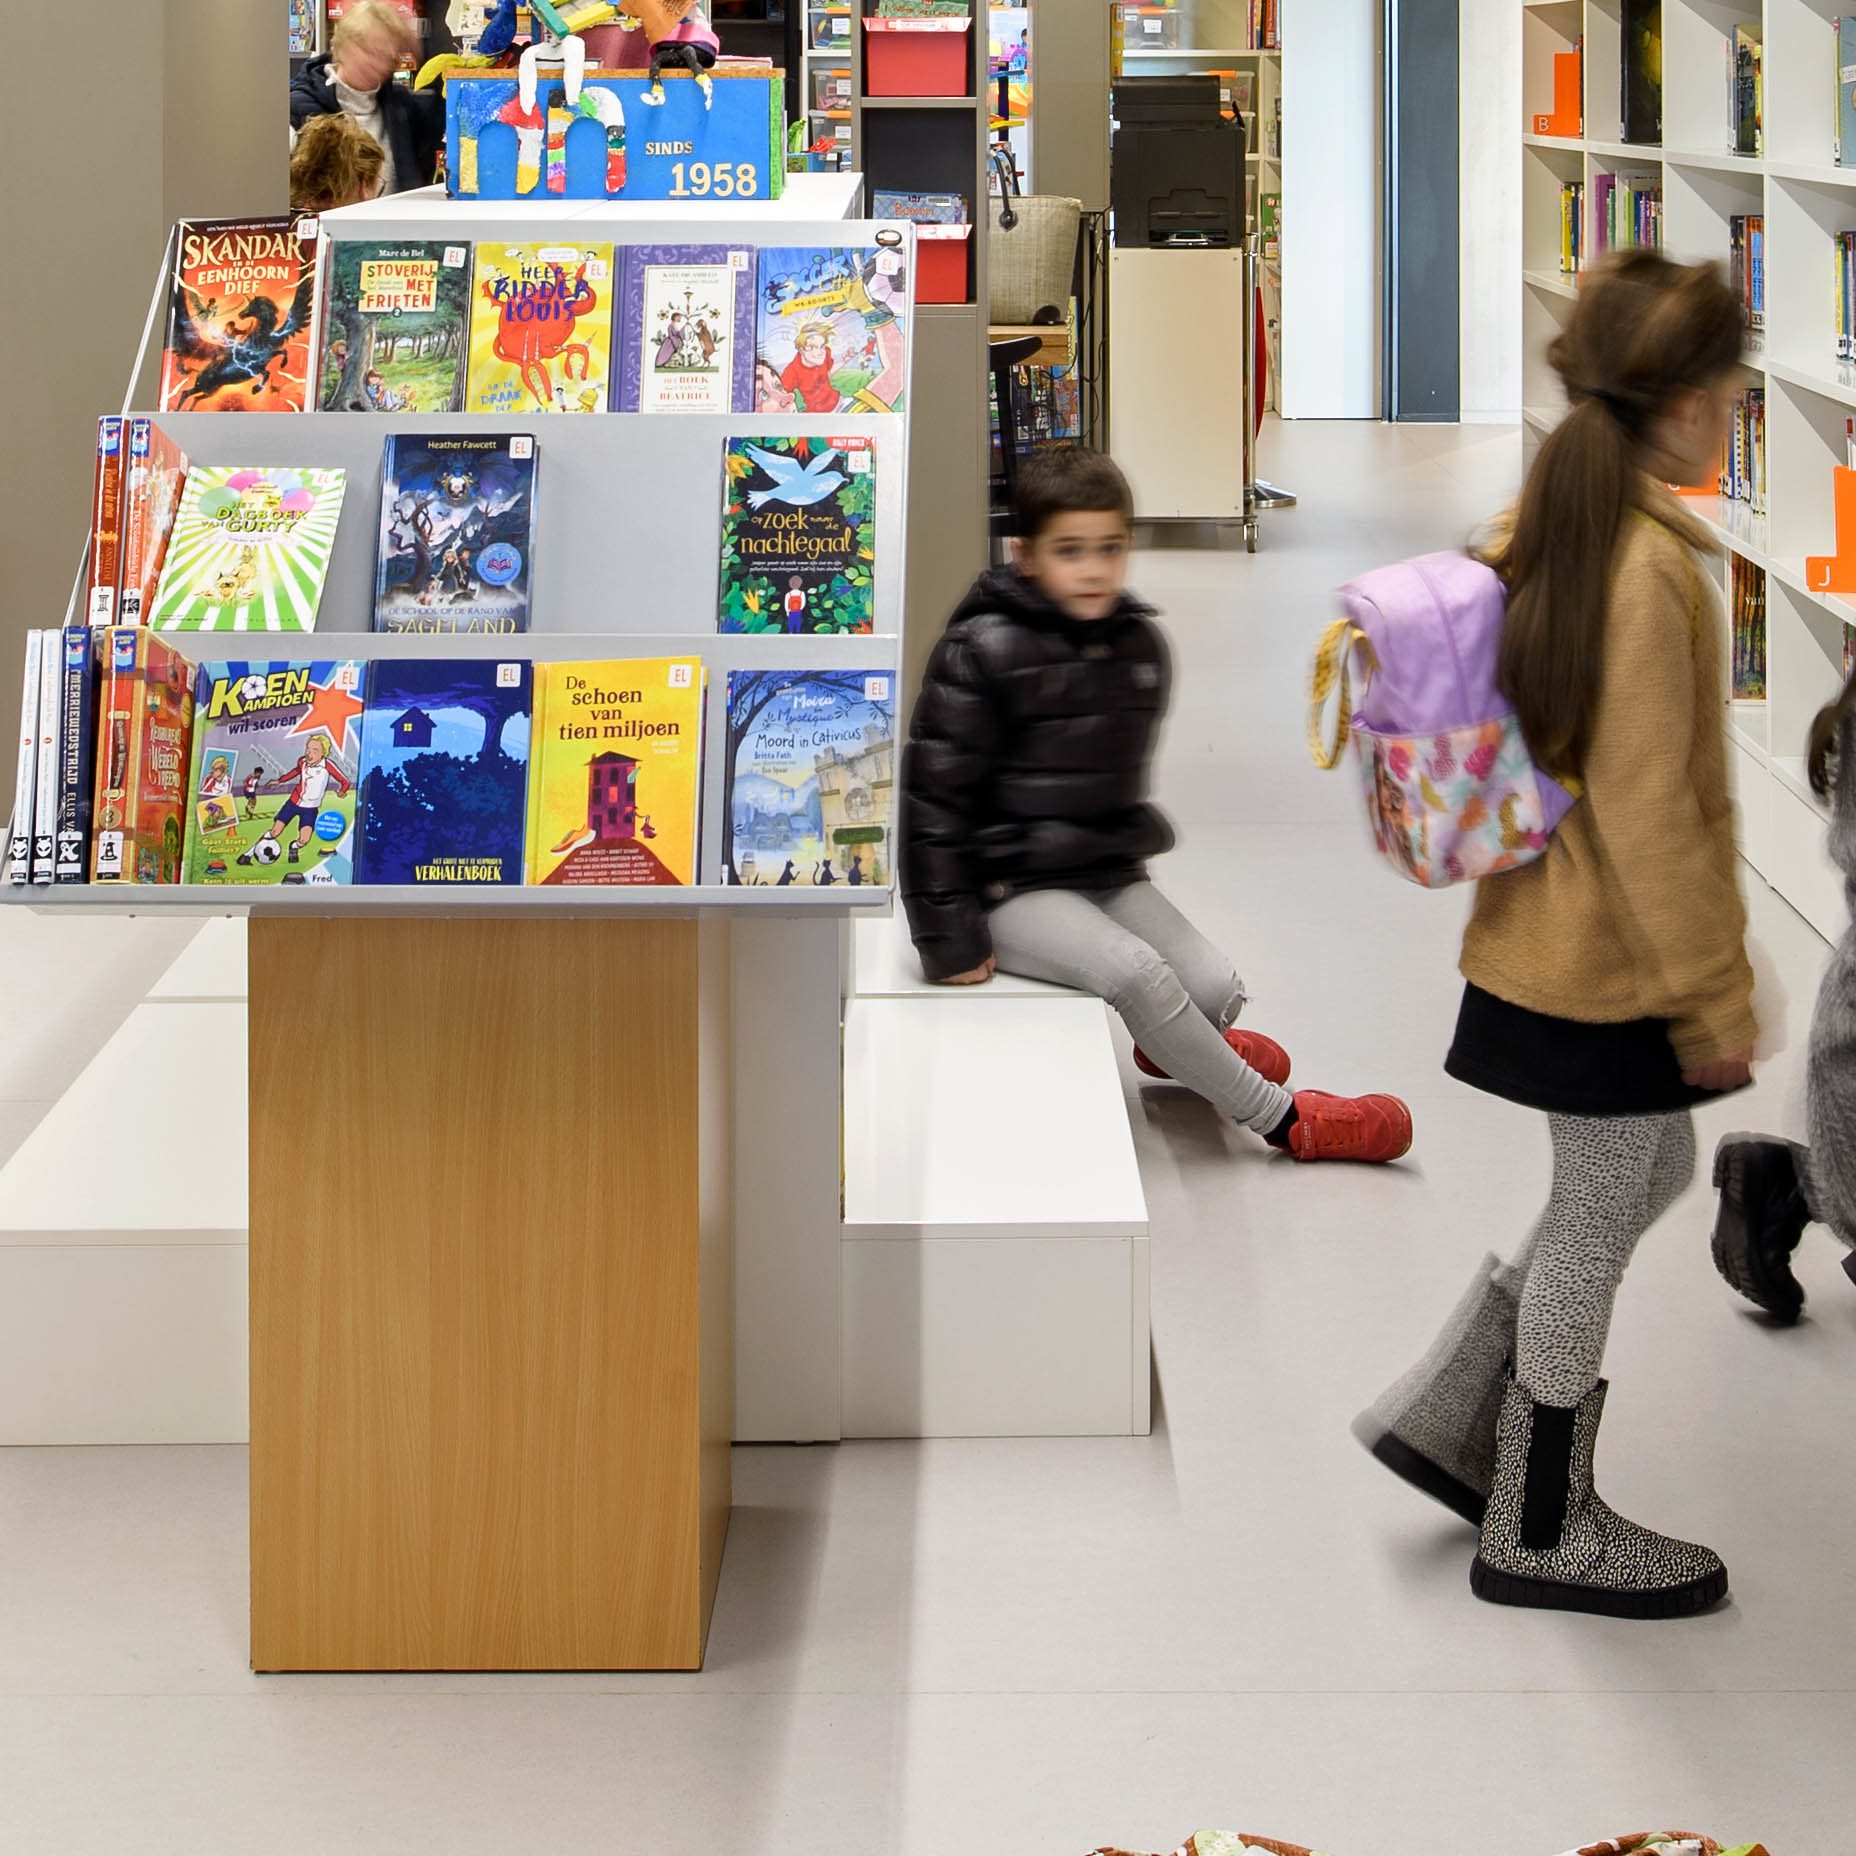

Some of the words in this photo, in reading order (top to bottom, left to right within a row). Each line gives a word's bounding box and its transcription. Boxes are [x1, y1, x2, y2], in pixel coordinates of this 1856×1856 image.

[1538, 117, 1549, 132] B
[645, 141, 694, 156] SINDS
[668, 162, 758, 197] 1958
[183, 232, 306, 269] SKANDAR
[379, 249, 398, 257] Marc
[400, 249, 409, 257] de
[449, 251, 459, 263] EL
[732, 256, 743, 266] EL
[198, 266, 289, 285] EENHOORN
[367, 264, 434, 277] STOVERIJ
[590, 266, 601, 276] EL
[225, 281, 260, 295] DIEF
[406, 279, 434, 292] MET
[506, 299, 577, 322] LOUIS
[428, 440, 461, 449] Heather
[463, 440, 496, 449] Fawcett
[514, 440, 527, 454] EL
[215, 508, 308, 521] DAGBOEK
[762, 507, 809, 530] zoek
[226, 520, 297, 533] GURTY
[741, 527, 852, 560] nachtegaal
[1818, 565, 1831, 587] J
[341, 671, 355, 685] EL
[502, 668, 516, 683] EL
[674, 669, 687, 683] EL
[566, 676, 587, 690] De
[872, 681, 885, 696] EL
[571, 689, 643, 705] schoen
[793, 695, 835, 708] Moira
[590, 708, 622, 721] van
[229, 721, 251, 736] wil
[253, 714, 298, 732] scoren
[559, 723, 598, 740] tien
[603, 721, 680, 742] miljoen
[756, 734, 795, 748] Moord
[800, 737, 808, 747] in
[812, 728, 862, 746] Cativicus
[754, 751, 775, 760] Britta
[65, 792, 77, 818] ELLIS
[106, 811, 117, 823] 3
[312, 874, 333, 884] Fred
[414, 865, 503, 882] VERHALENBOEK
